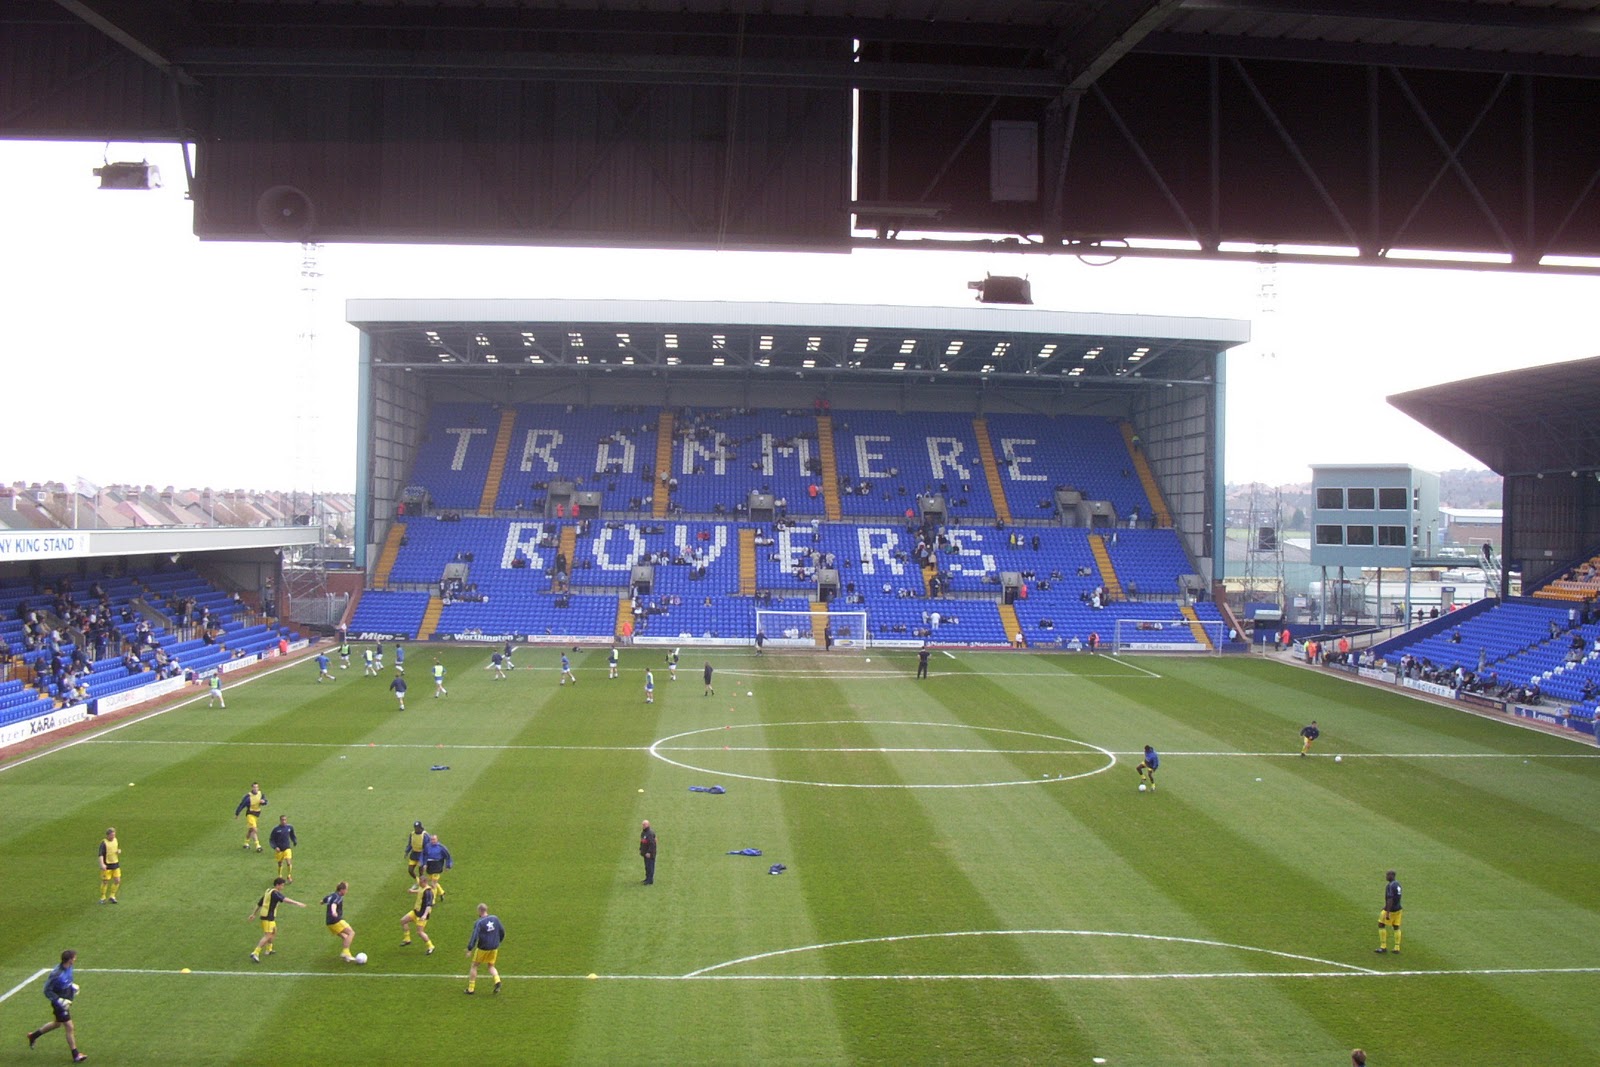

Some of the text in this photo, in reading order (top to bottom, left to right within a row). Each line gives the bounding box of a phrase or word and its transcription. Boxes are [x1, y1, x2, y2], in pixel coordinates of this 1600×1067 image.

[446, 427, 1048, 481] TRANMERE
[15, 538, 40, 553] KING
[43, 537, 74, 552] STAND
[501, 522, 996, 576] ROVERS
[359, 632, 394, 641] Mitre
[453, 633, 514, 642] Worthington
[1532, 710, 1556, 724] Loans
[30, 716, 56, 735] XARA
